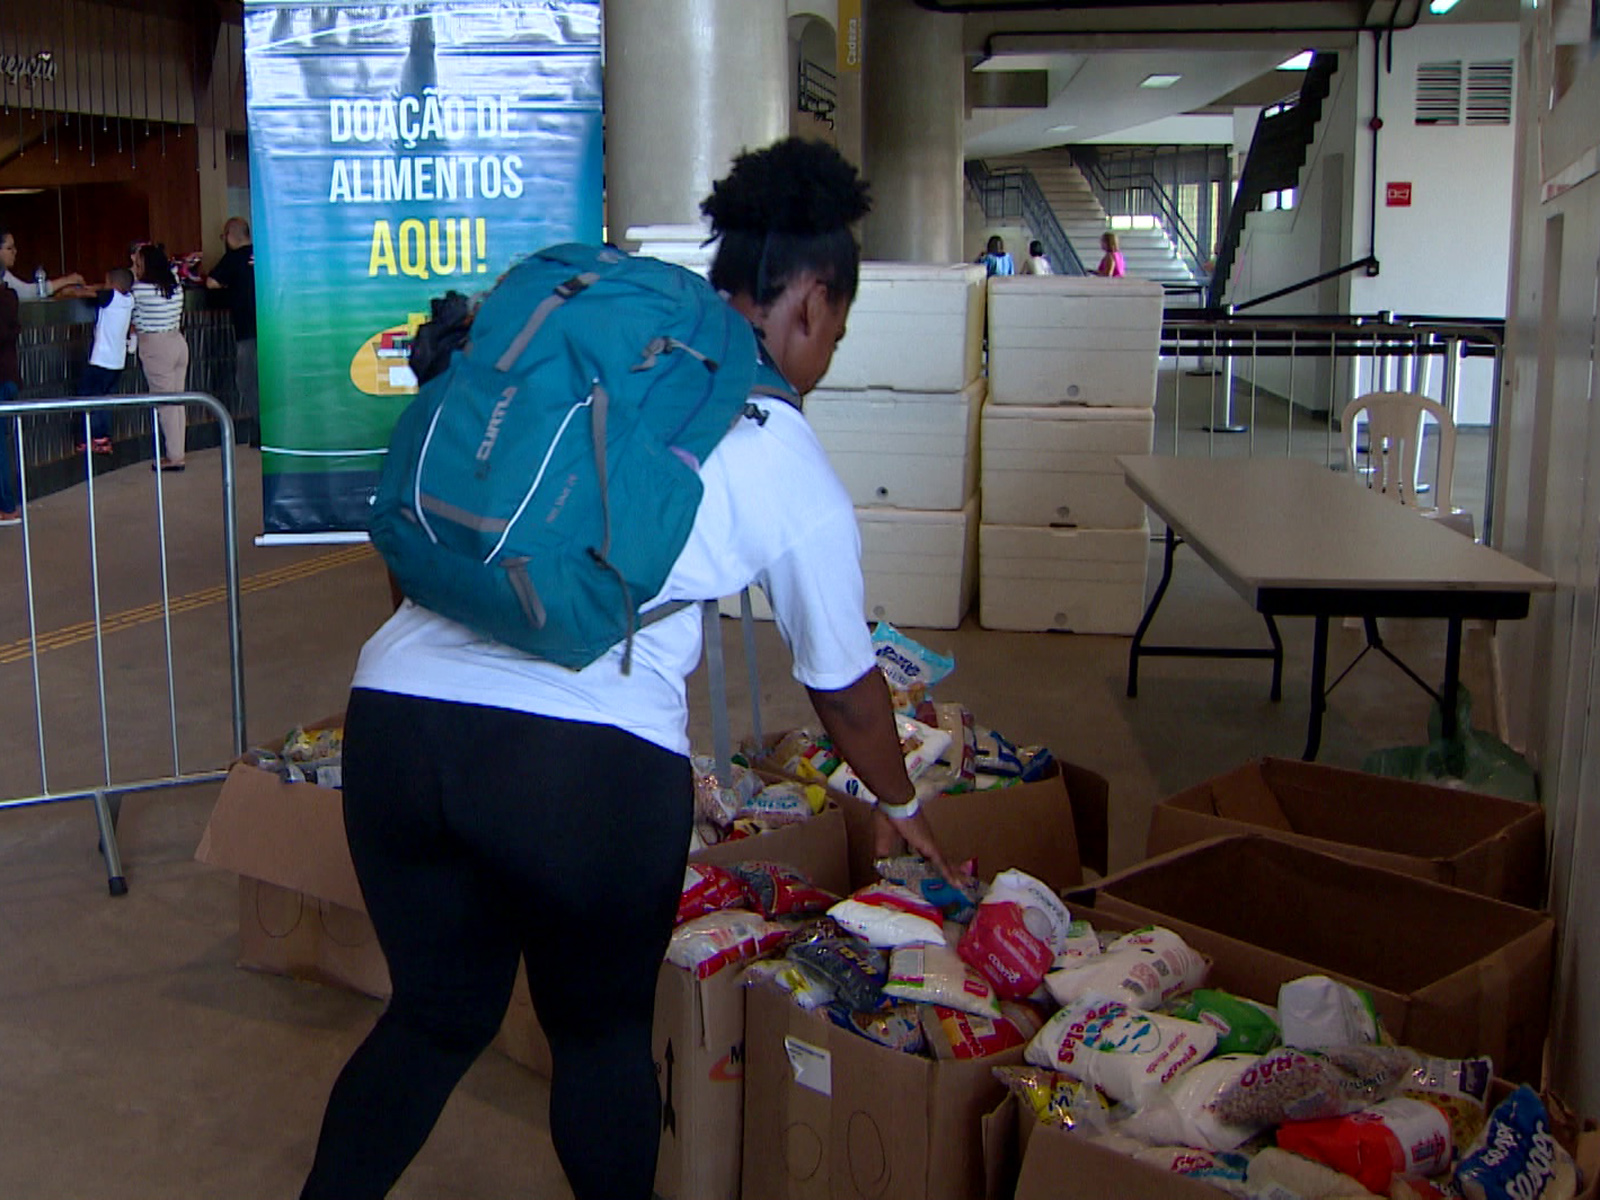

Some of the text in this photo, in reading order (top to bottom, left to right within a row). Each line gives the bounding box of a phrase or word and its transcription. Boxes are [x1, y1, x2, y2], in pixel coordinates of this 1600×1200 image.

[330, 86, 520, 148] DOAÇÃO DE
[328, 155, 524, 203] ALIMENTOS
[368, 217, 488, 279] AQUI!
